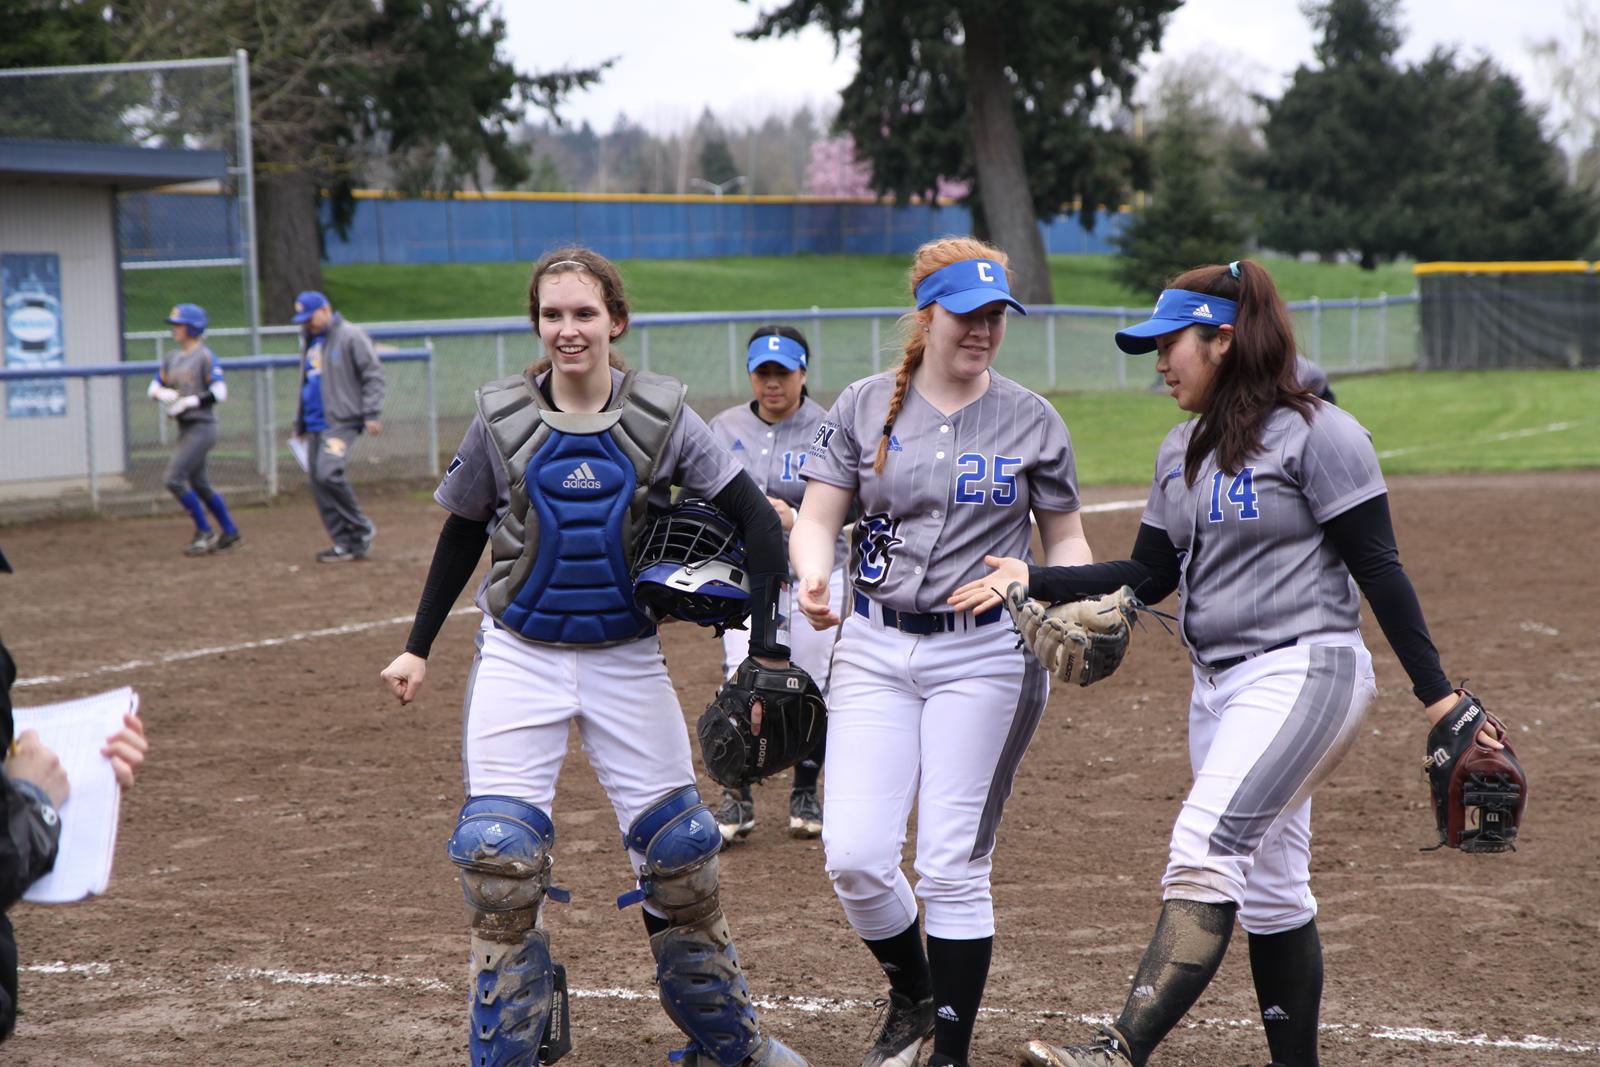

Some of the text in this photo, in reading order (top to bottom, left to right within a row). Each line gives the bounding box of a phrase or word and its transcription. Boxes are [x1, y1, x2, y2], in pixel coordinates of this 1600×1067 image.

[977, 262, 994, 282] C
[767, 336, 780, 351] C
[562, 478, 602, 489] adidas
[954, 452, 1023, 506] 25
[1208, 466, 1260, 523] 14
